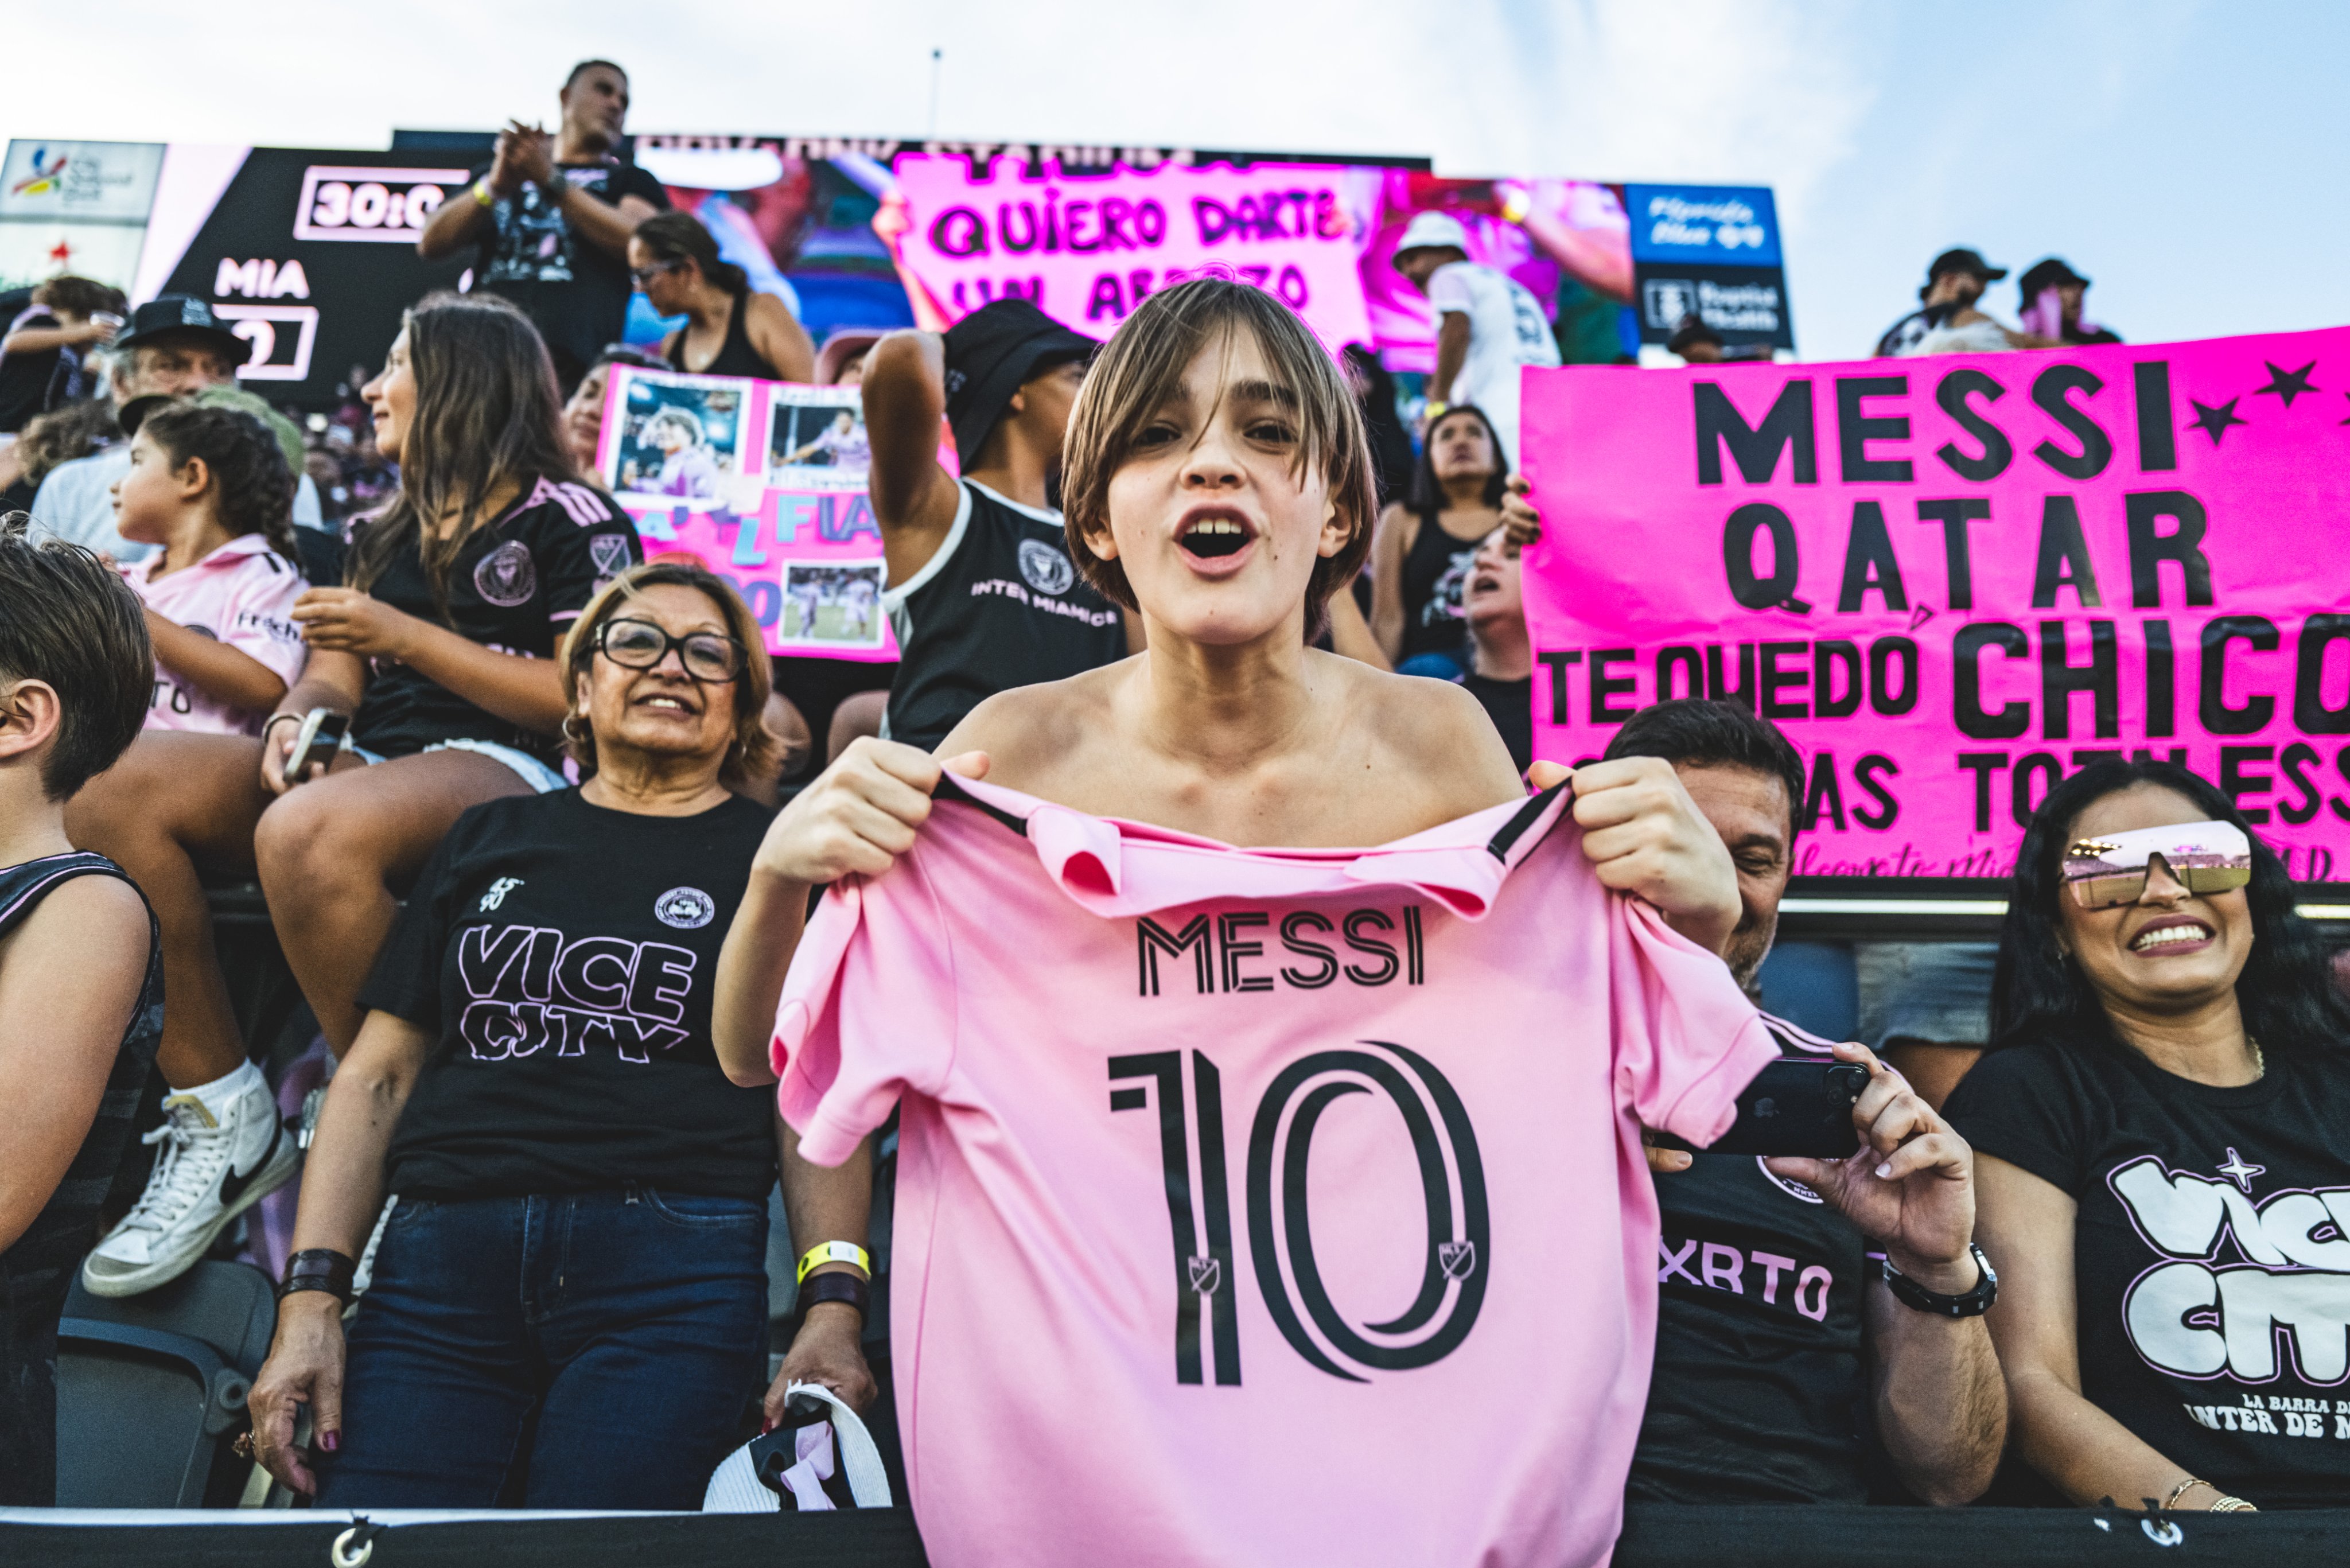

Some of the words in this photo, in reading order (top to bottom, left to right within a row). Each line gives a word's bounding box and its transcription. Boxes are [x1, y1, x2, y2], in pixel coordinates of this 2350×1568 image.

[928, 188, 1165, 256] QUIERO
[214, 257, 310, 299] MIA
[1691, 360, 2177, 487] MESSI
[1722, 491, 2216, 616] QATAR
[1536, 647, 1637, 726] TE
[459, 924, 697, 1025] VICE
[1136, 906, 1425, 997] MESSI
[1107, 1040, 1491, 1388] 10
[2123, 1260, 2350, 1387] CIT
[2182, 1403, 2279, 1435] INTER
[2284, 1412, 2324, 1438] DE
[2242, 1393, 2265, 1409] LA
[2269, 1395, 2330, 1414] BARRA
